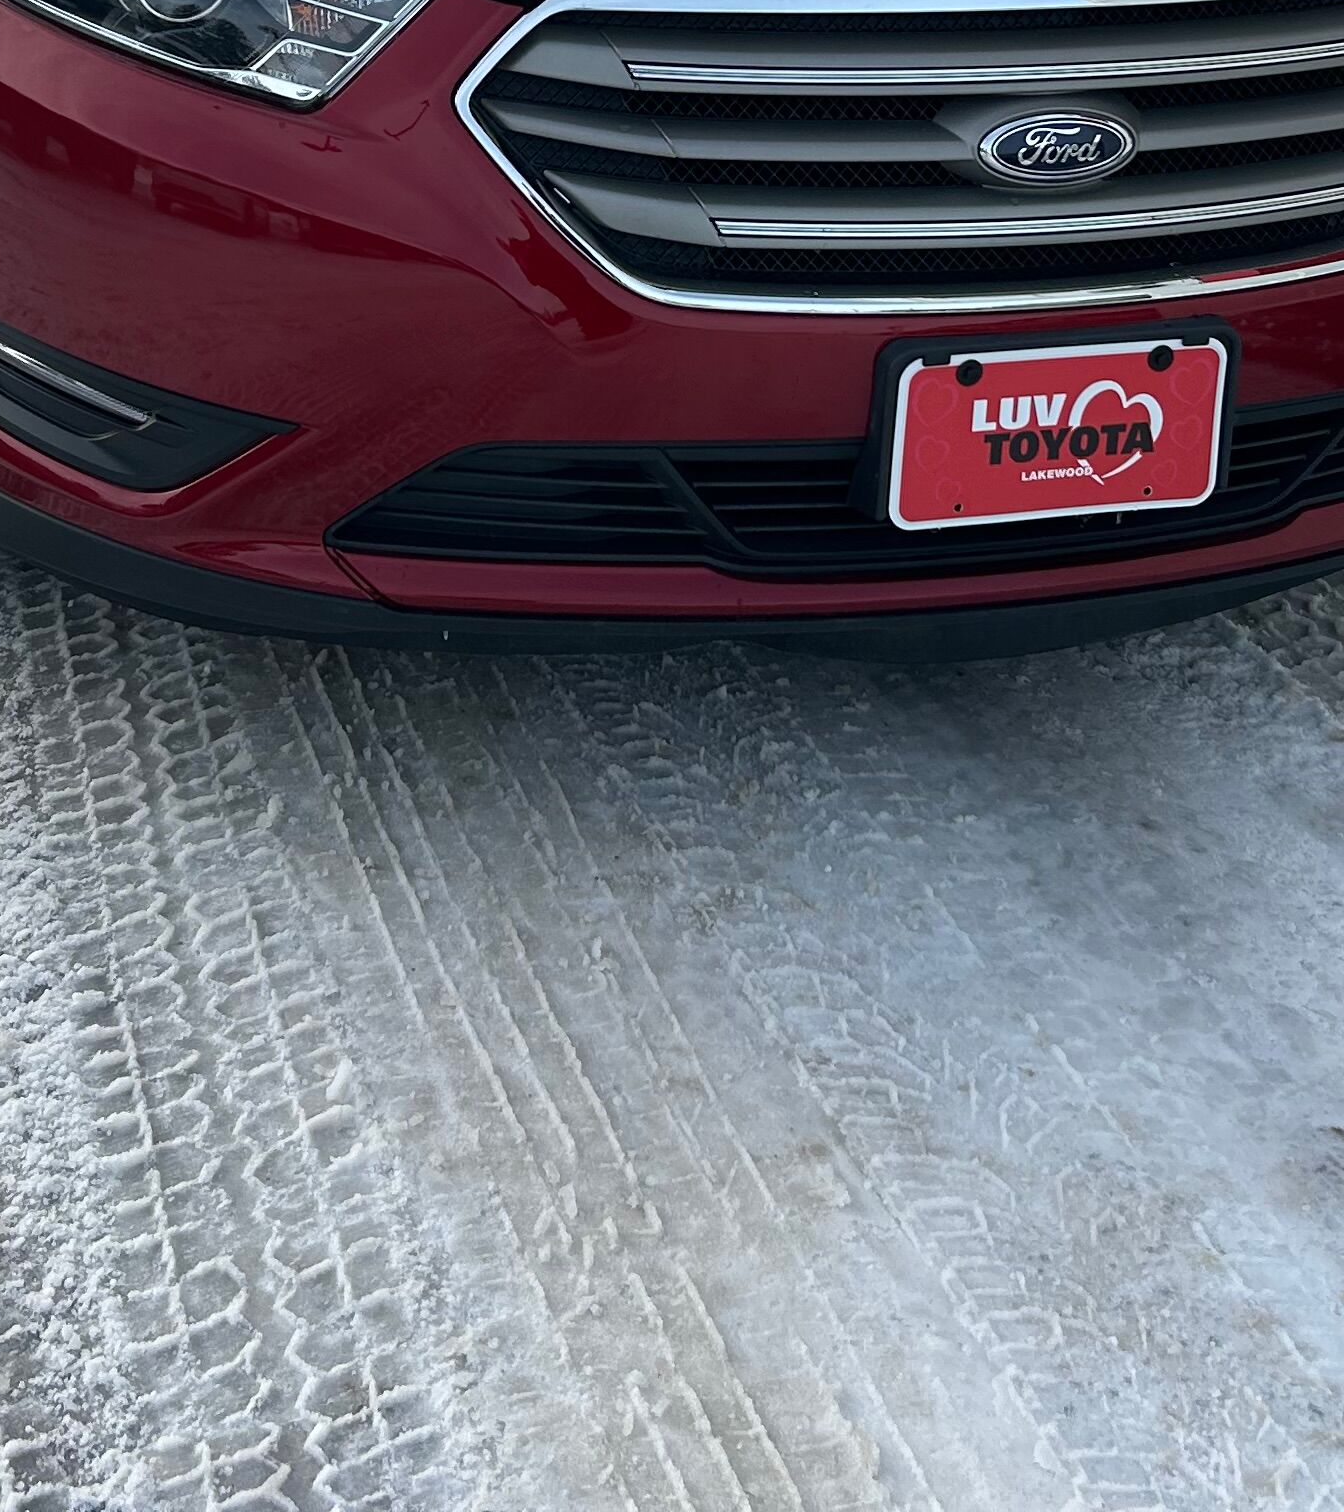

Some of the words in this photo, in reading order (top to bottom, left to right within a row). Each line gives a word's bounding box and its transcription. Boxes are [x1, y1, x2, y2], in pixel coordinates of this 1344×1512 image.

[1017, 126, 1102, 166] Ford
[972, 393, 1067, 432] LUV
[984, 422, 1153, 465] TOYOTA
[1021, 465, 1095, 481] LAKEWOOD
